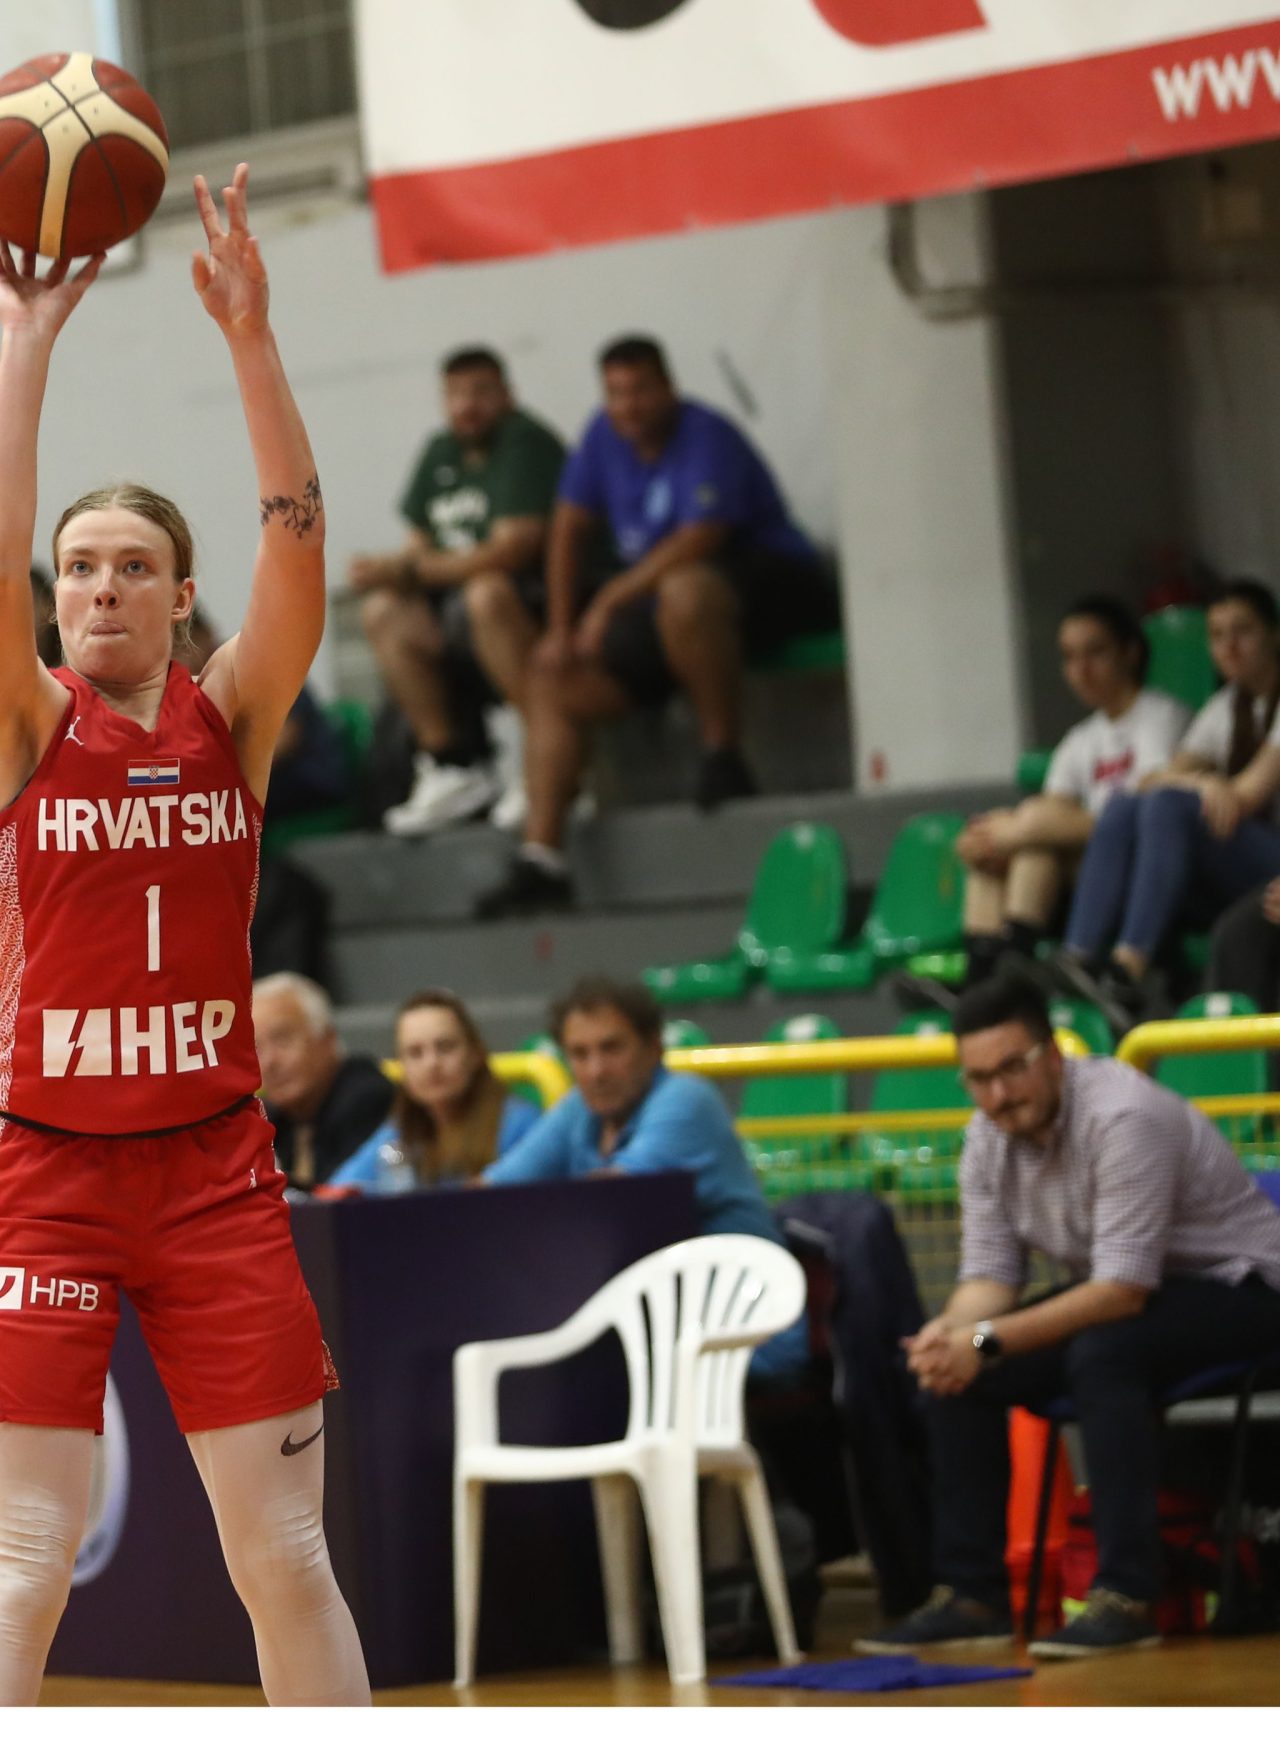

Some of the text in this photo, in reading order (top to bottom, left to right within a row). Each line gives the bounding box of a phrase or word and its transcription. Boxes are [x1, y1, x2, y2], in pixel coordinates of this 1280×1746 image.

[37, 787, 249, 853] HRVATSKA
[144, 884, 161, 972] 1
[119, 999, 236, 1077] HEP
[28, 1274, 100, 1312] HPB
